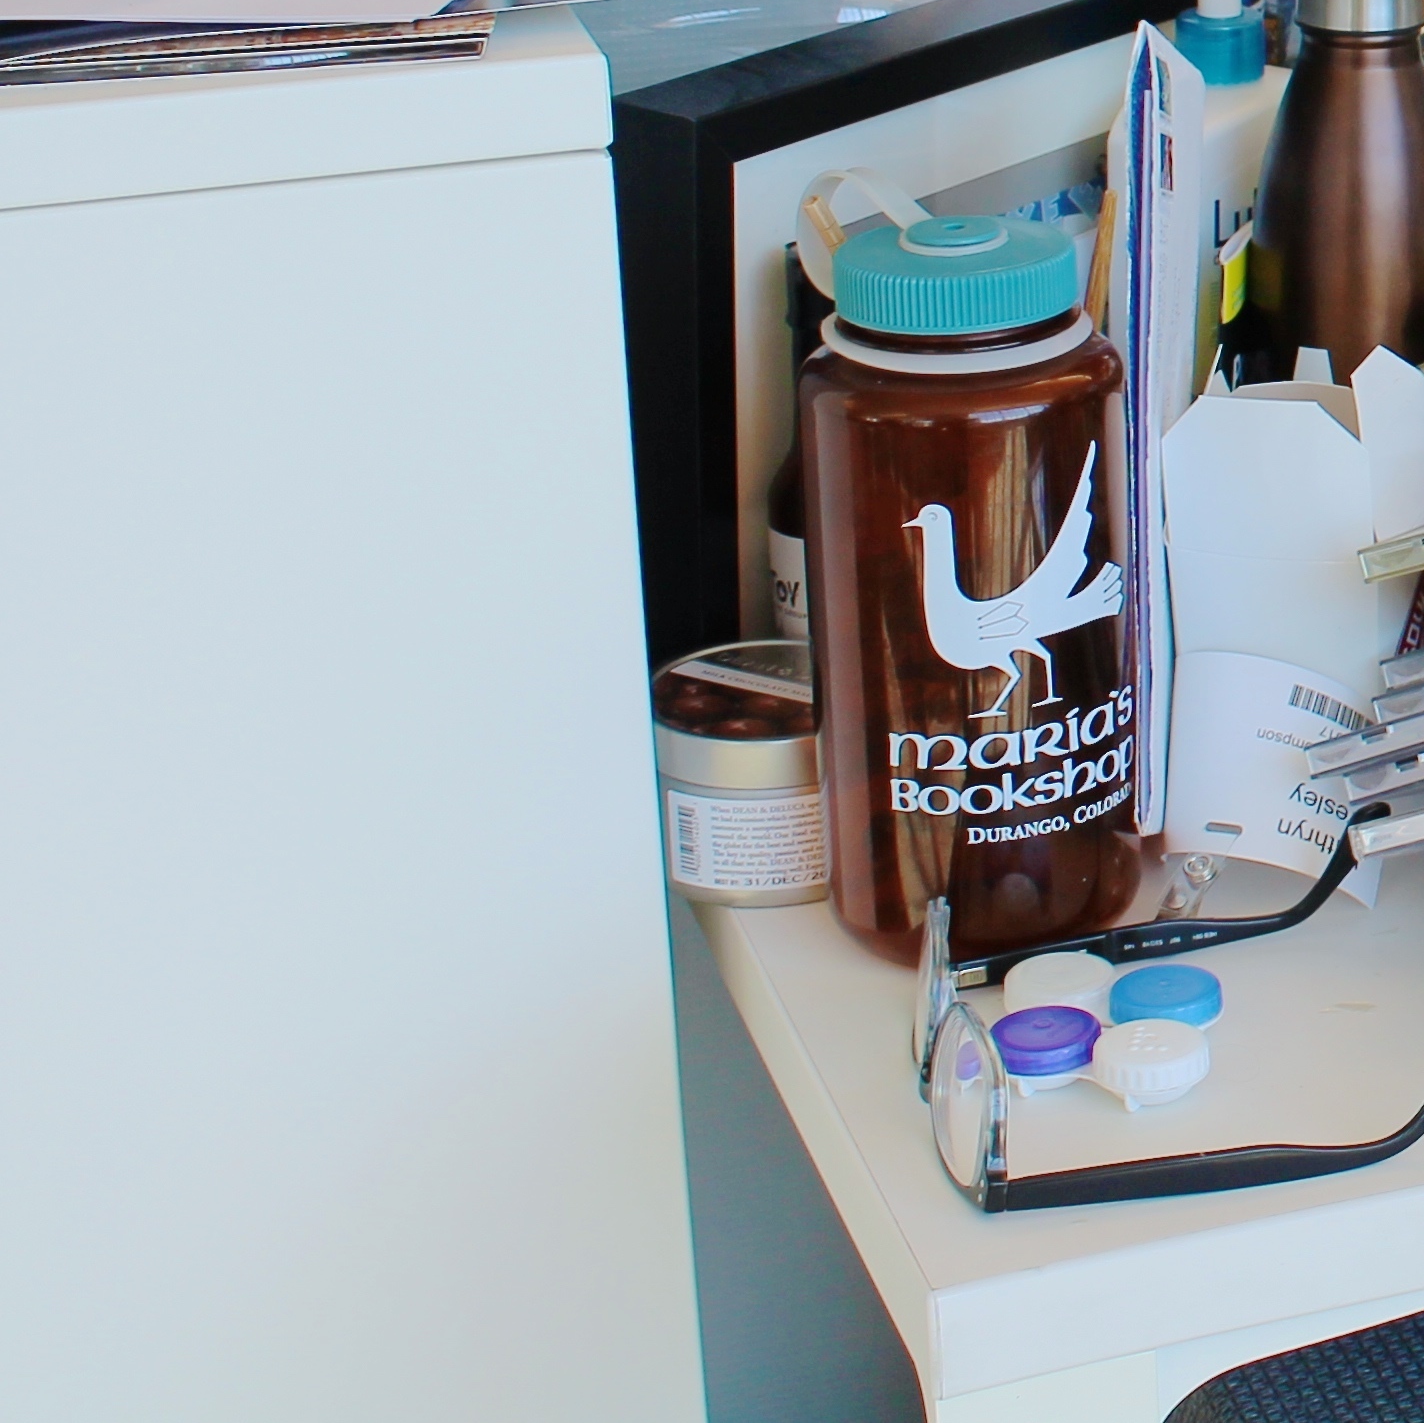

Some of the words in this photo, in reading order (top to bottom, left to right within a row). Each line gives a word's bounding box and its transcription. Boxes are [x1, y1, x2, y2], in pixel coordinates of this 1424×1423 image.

[732, 806, 758, 815] DEAN
[769, 803, 806, 813] DELUCA
[1288, 782, 1350, 821] esley
[1276, 817, 1338, 856] thryn
